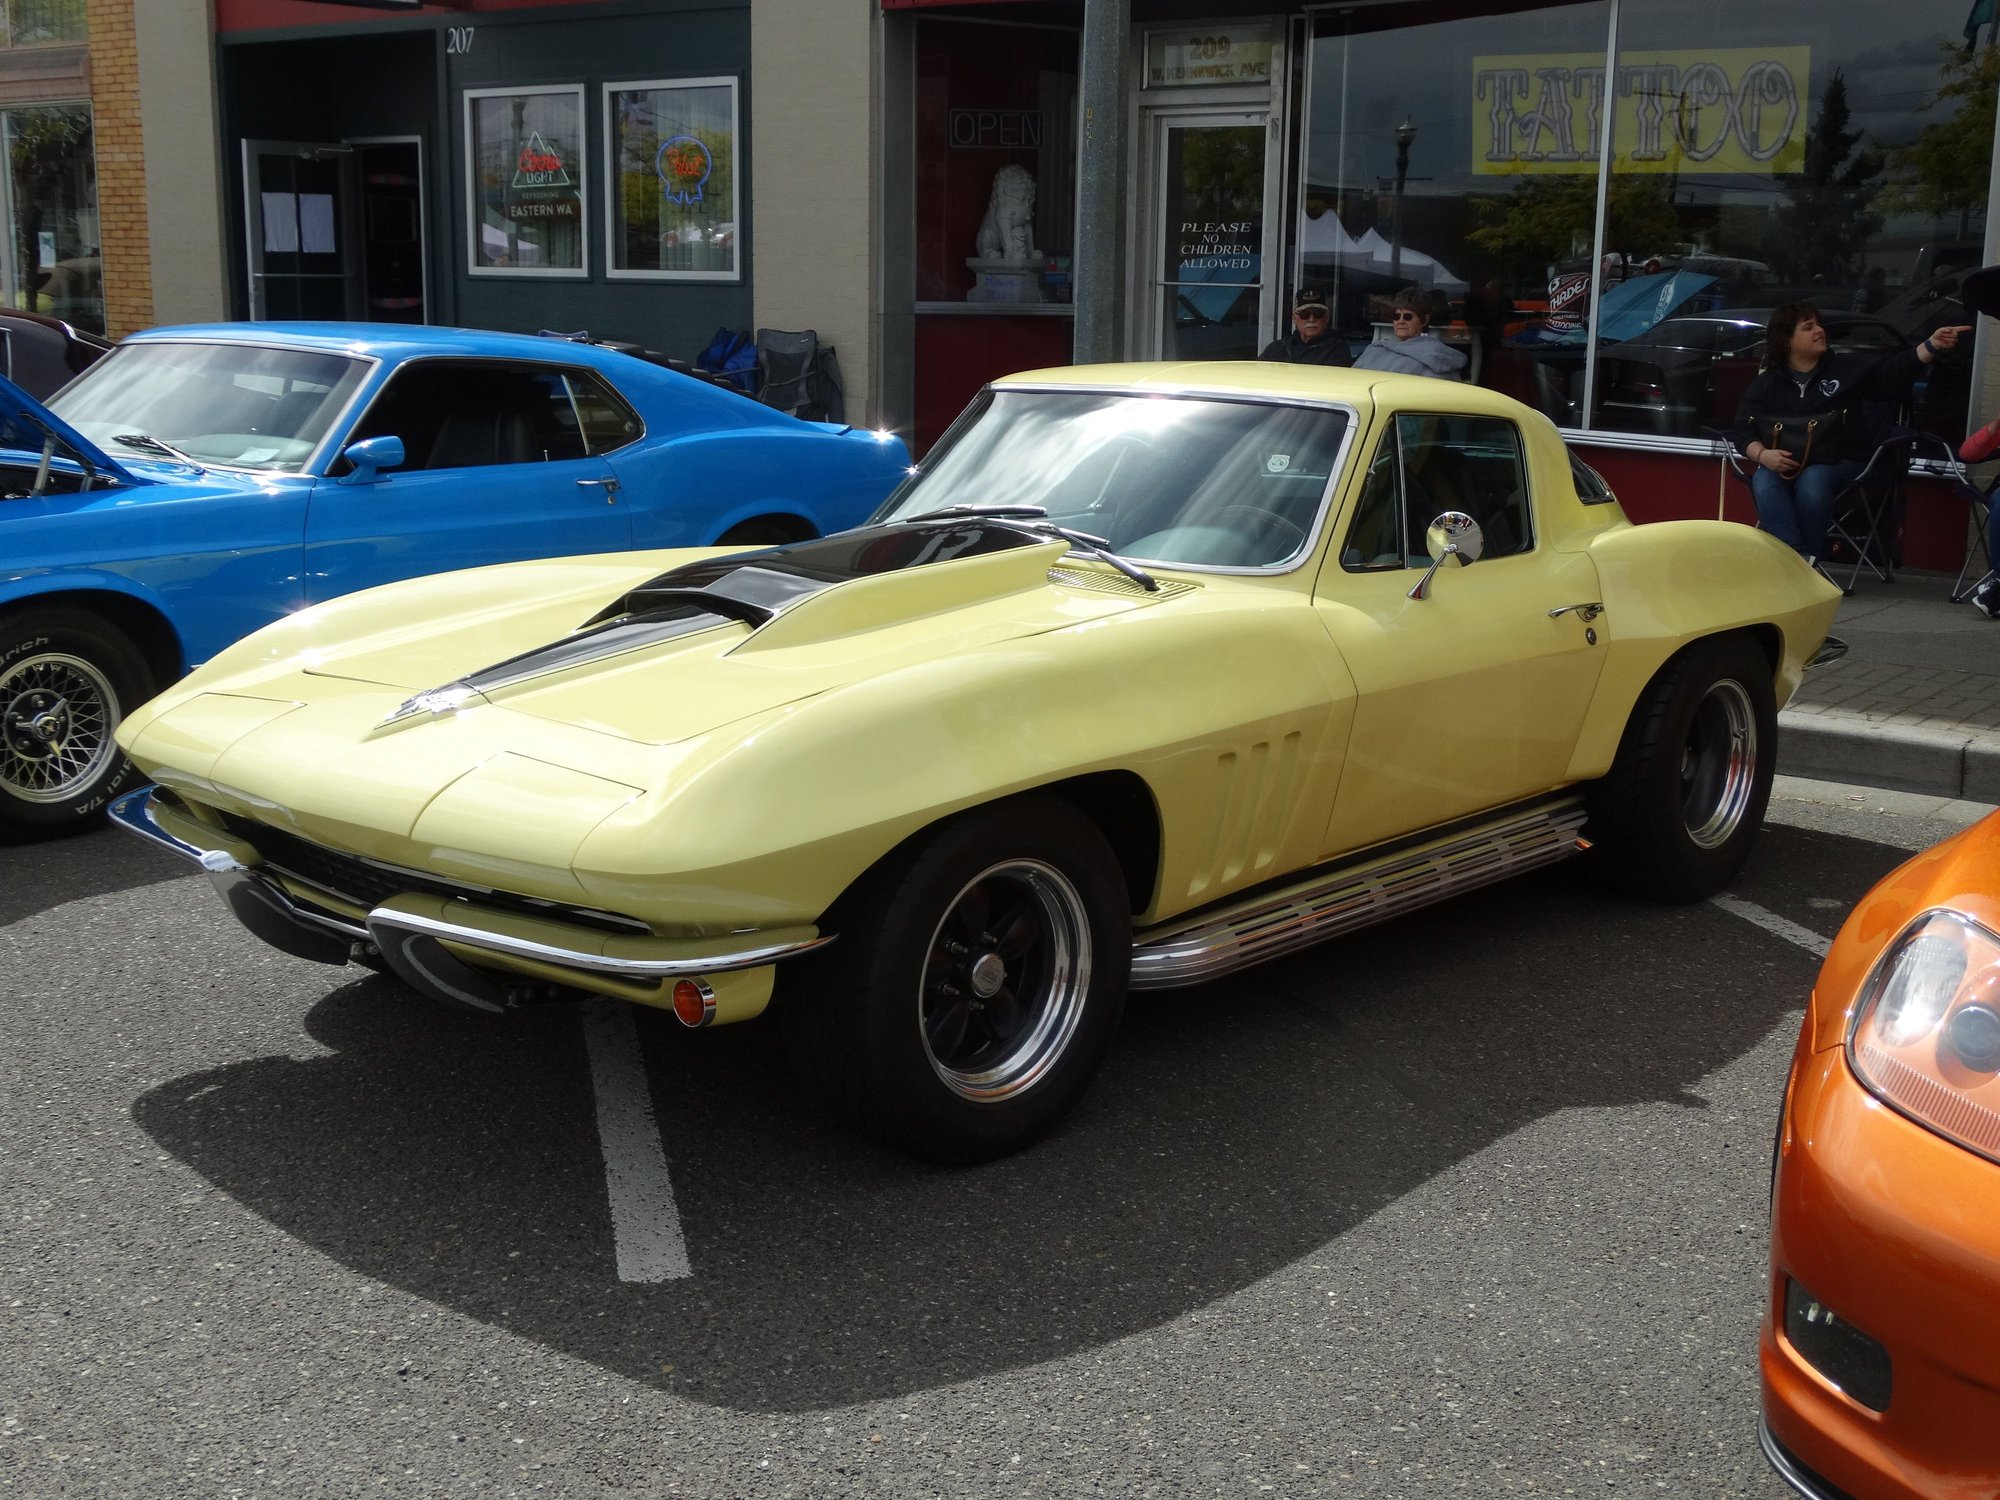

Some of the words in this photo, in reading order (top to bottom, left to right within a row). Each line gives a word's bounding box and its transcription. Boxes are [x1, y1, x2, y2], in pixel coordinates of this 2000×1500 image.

[446, 27, 475, 54] 207
[1189, 36, 1231, 60] 209
[1477, 61, 1799, 163] TATTOO
[954, 112, 1041, 145] OPEN
[518, 147, 563, 173] Coors
[667, 148, 704, 177] Pabst
[526, 170, 554, 184] LIGHT
[510, 204, 554, 218] EASTERN
[556, 203, 573, 216] WA
[1181, 222, 1253, 233] PLEASE
[1201, 233, 1220, 244] NO
[1181, 244, 1253, 256] CHILDREN
[1180, 258, 1251, 270] ALLOWED
[1548, 319, 1582, 330] TATTOOING
[75, 796, 106, 815] T/A
